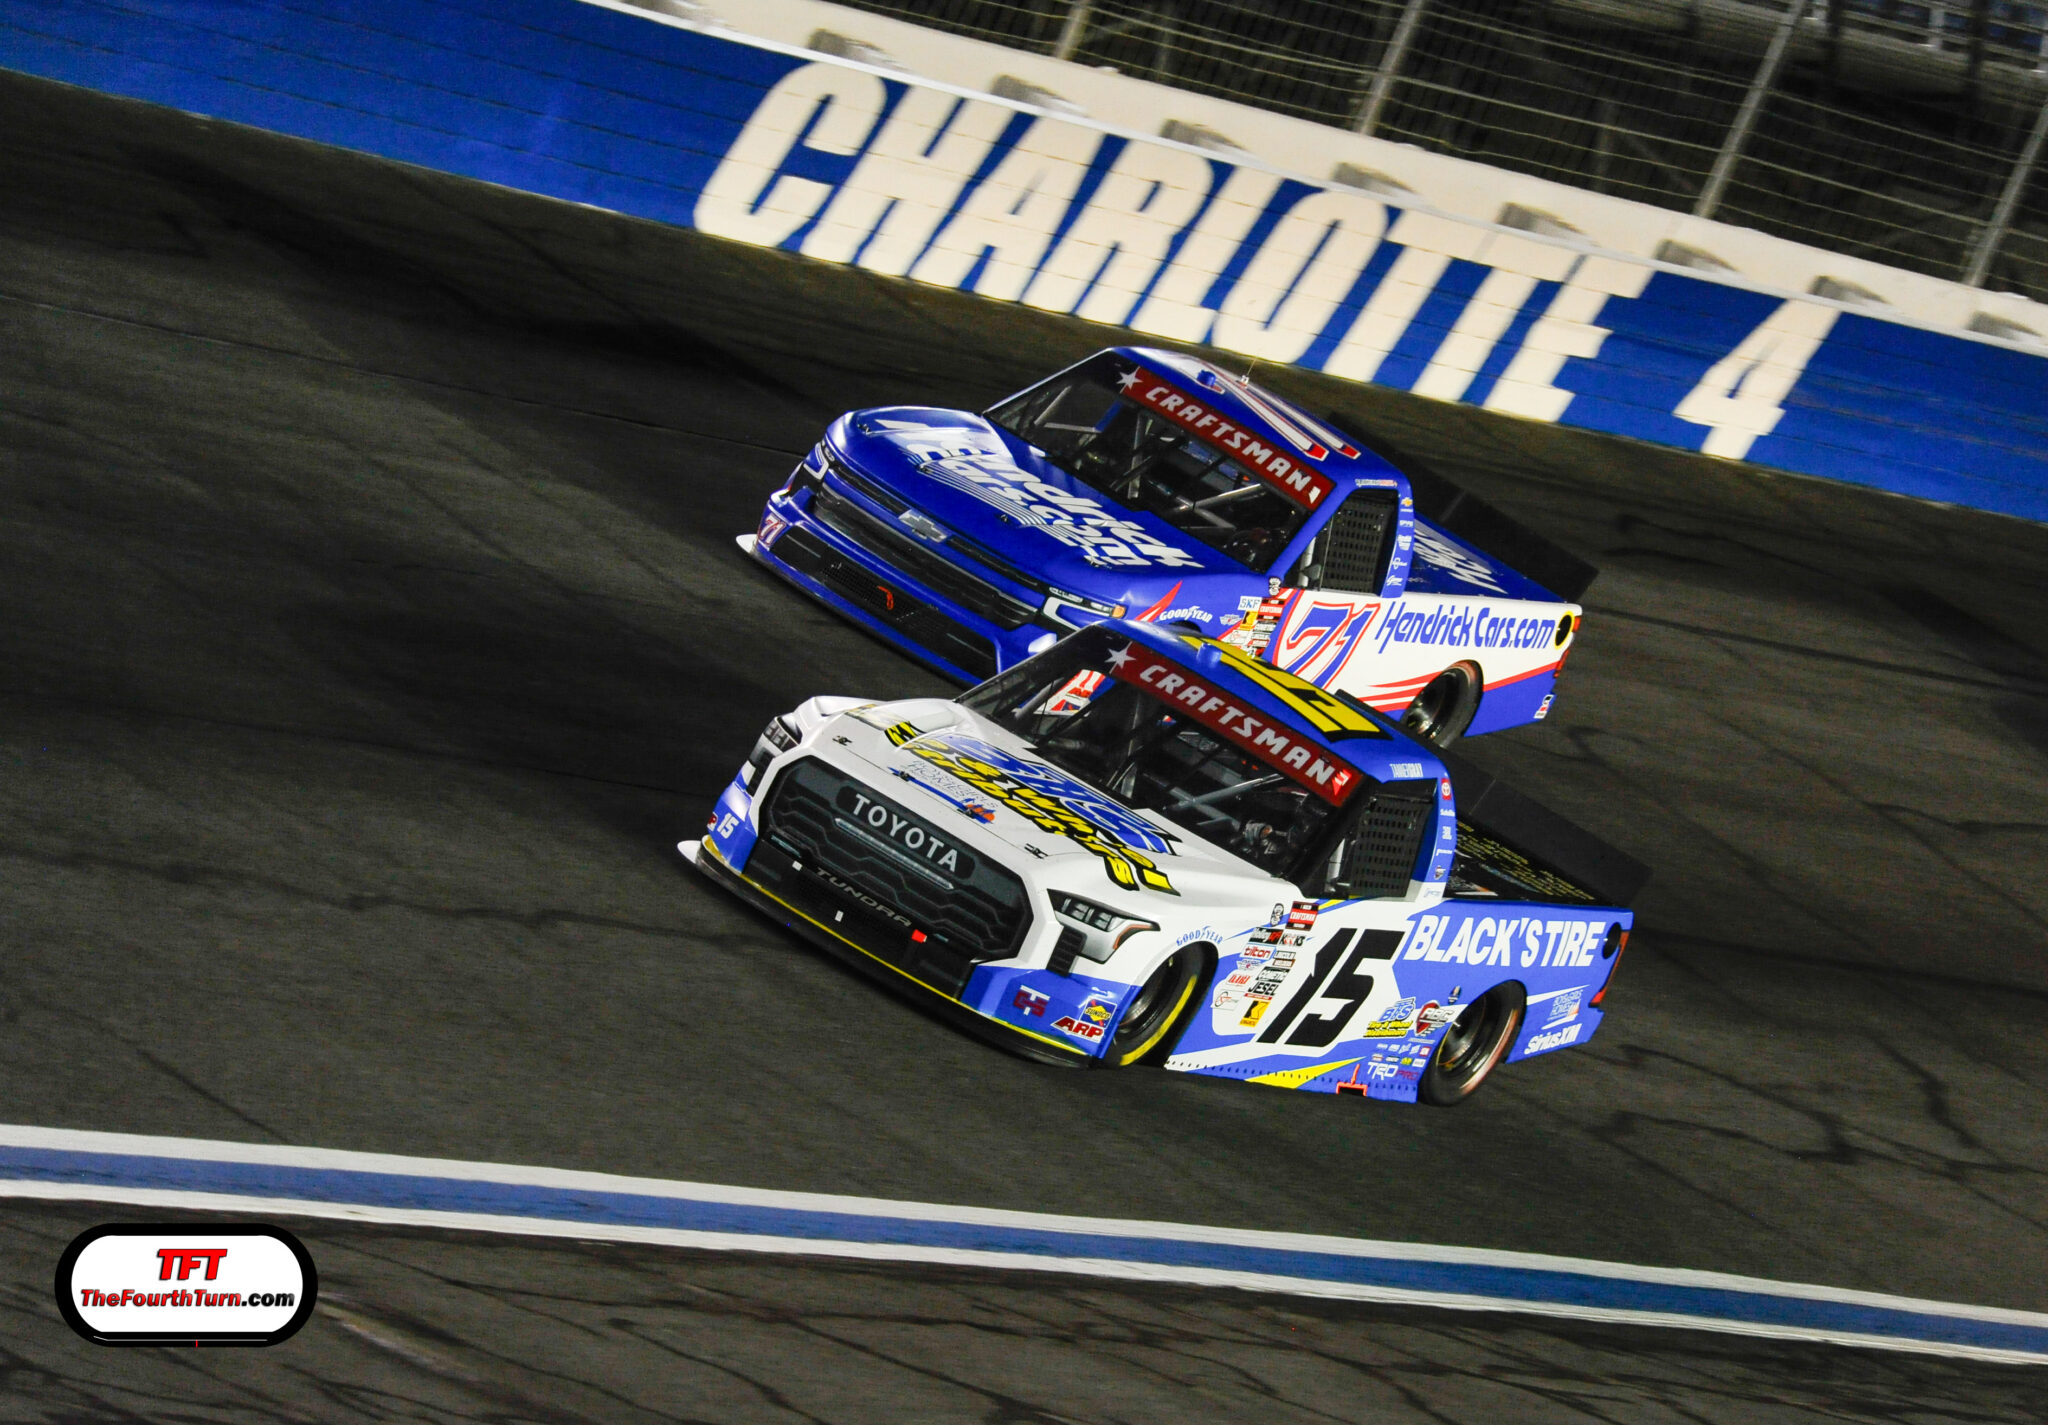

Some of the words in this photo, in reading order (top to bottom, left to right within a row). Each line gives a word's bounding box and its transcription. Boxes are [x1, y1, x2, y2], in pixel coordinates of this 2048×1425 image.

[694, 60, 1657, 424] CHARLOTTE
[1674, 297, 1840, 461] 4
[1145, 386, 1313, 492] CRAFTSMAN
[1159, 606, 1213, 623] GOODYEAR
[1240, 599, 1260, 609] SKF
[1284, 601, 1381, 692] 71
[1140, 665, 1335, 785] CRAFTSMAN
[716, 812, 740, 839] 15
[853, 793, 958, 873] TOYOTA
[816, 867, 912, 927] TUNDRA
[1176, 925, 1223, 947] GOODYEAR
[1243, 945, 1272, 959] tilton
[1247, 981, 1279, 997] JESEL
[1258, 928, 1406, 1048] 15
[1054, 1016, 1104, 1038] ARP
[1085, 1007, 1111, 1020] SUNOCO
[1524, 1023, 1583, 1054] SiriusXM
